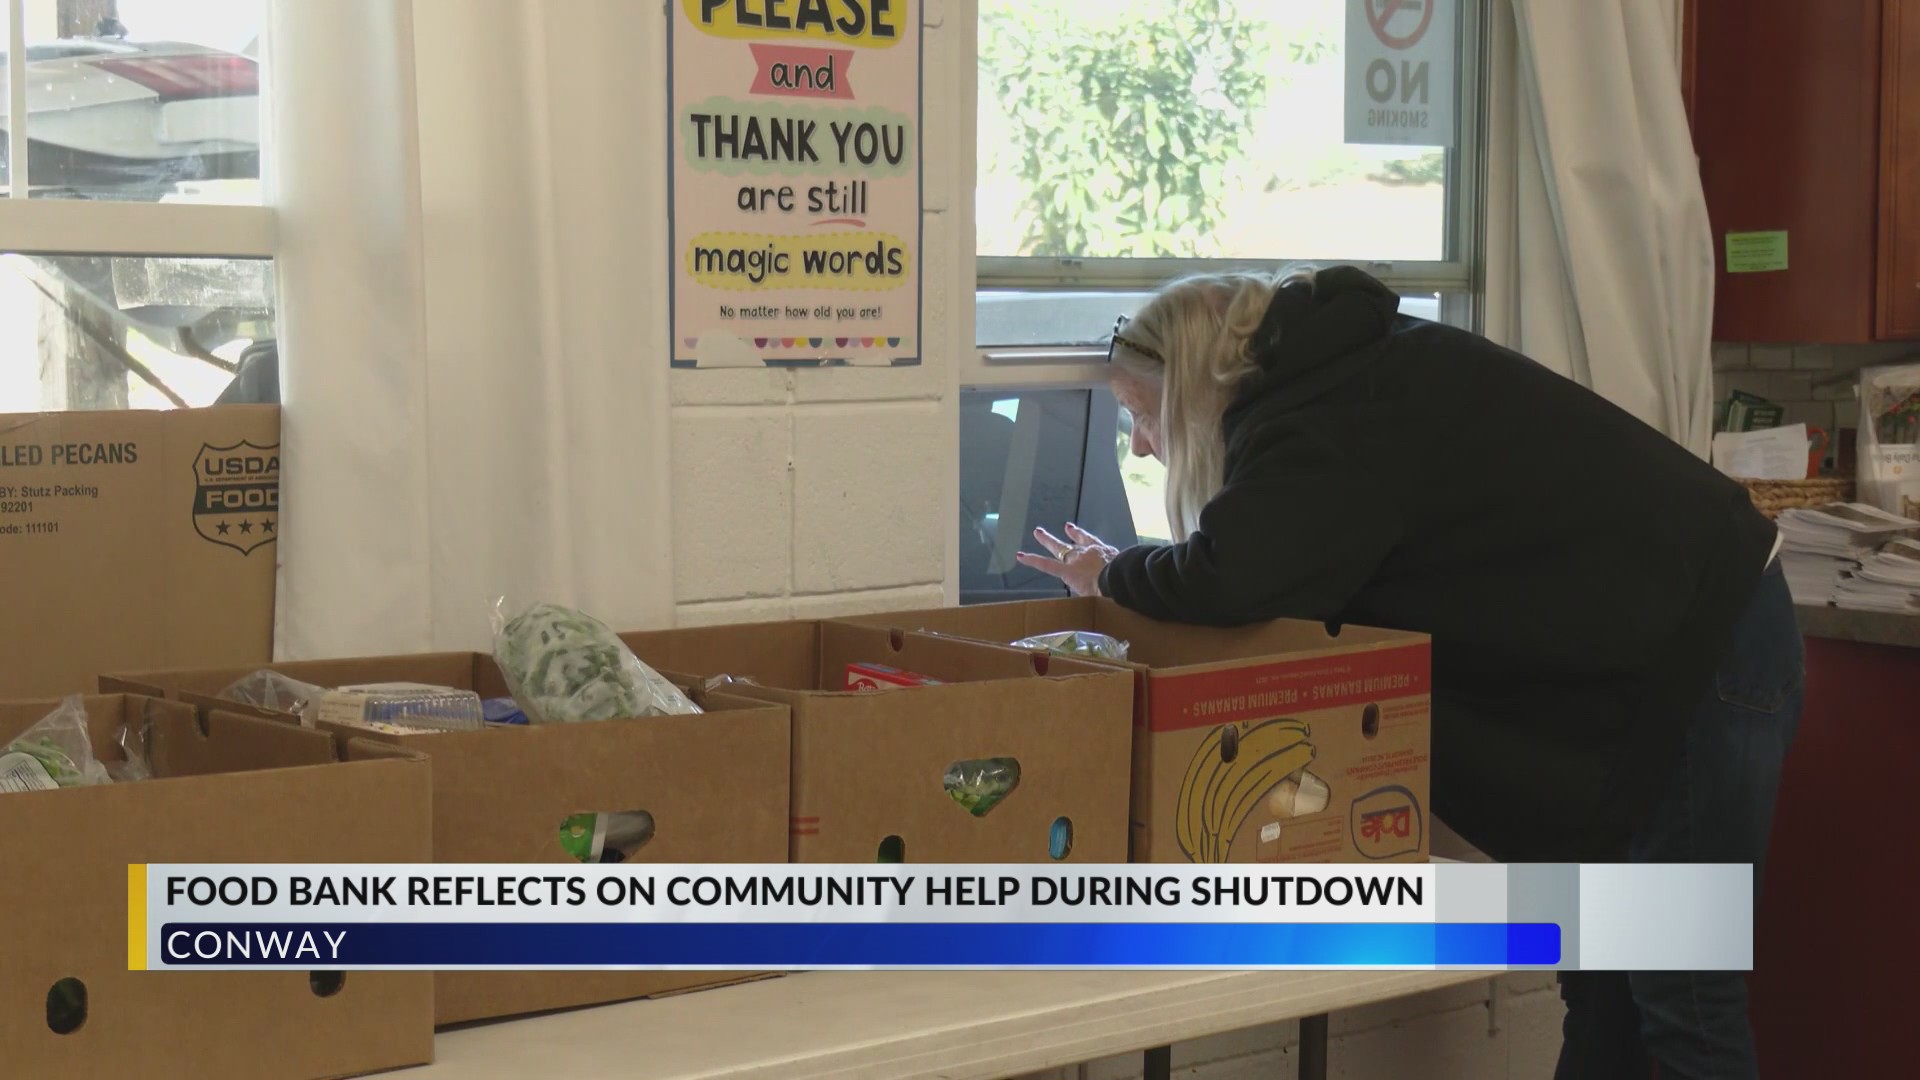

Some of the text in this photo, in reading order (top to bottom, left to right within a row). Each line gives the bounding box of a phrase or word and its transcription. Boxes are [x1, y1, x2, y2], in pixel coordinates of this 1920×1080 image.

[701, 0, 896, 38] PLEASE
[770, 55, 836, 91] and
[690, 113, 904, 166] THANK YOU
[737, 180, 867, 214] are still
[694, 240, 903, 284] magic words
[720, 305, 881, 321] No matter how old you are!
[51, 442, 138, 466] PECANS
[204, 456, 280, 476] USDA
[0, 484, 99, 499] BY: Stutz Packing
[206, 488, 279, 509] FOOD
[1, 501, 33, 513] 92201
[26, 522, 59, 534] 111101
[1312, 679, 1361, 700] BANANAS
[1363, 673, 1410, 693] PREMIUM
[1192, 695, 1245, 717] BANANAS
[1247, 688, 1298, 709] PREMIUM
[1360, 808, 1411, 844] Dole
